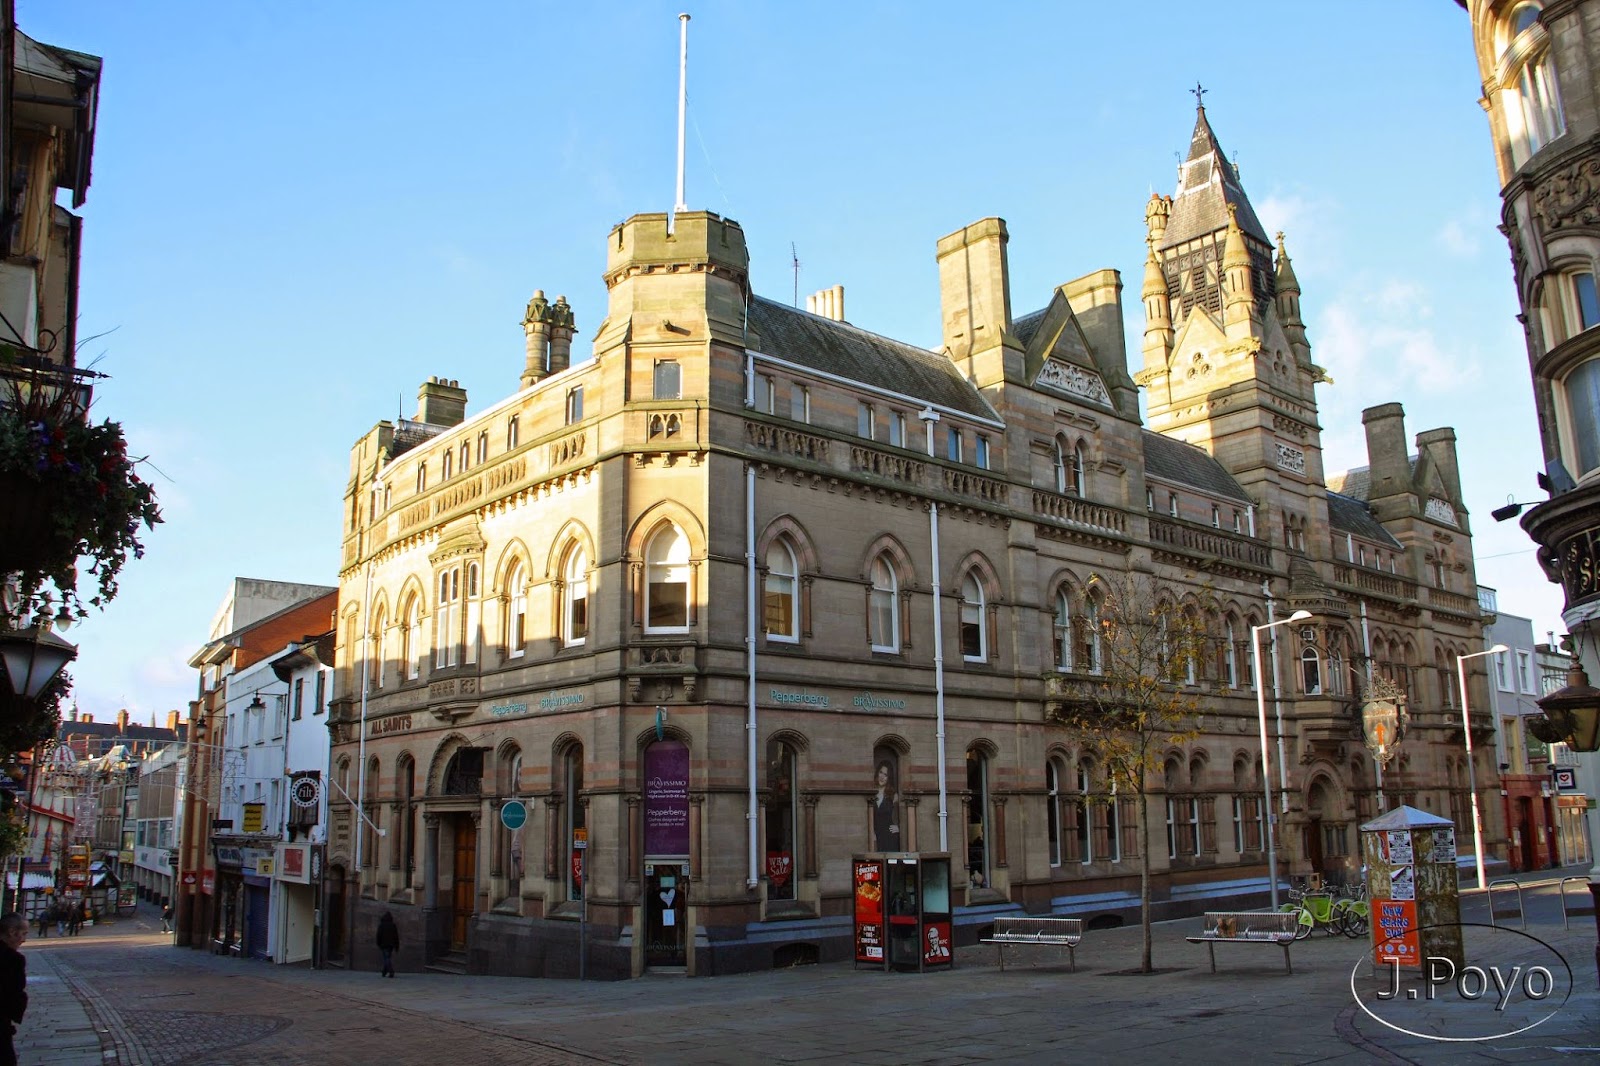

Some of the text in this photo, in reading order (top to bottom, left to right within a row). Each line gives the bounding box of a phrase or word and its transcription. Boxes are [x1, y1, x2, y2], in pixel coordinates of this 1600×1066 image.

[541, 691, 584, 711] BRAVISSIMO
[770, 687, 906, 712] Pepperberry BRAVISSIMO
[371, 714, 412, 736] ALL SAINTS
[648, 776, 686, 788] BRAVISSIMO
[648, 806, 686, 816] Pepperberry
